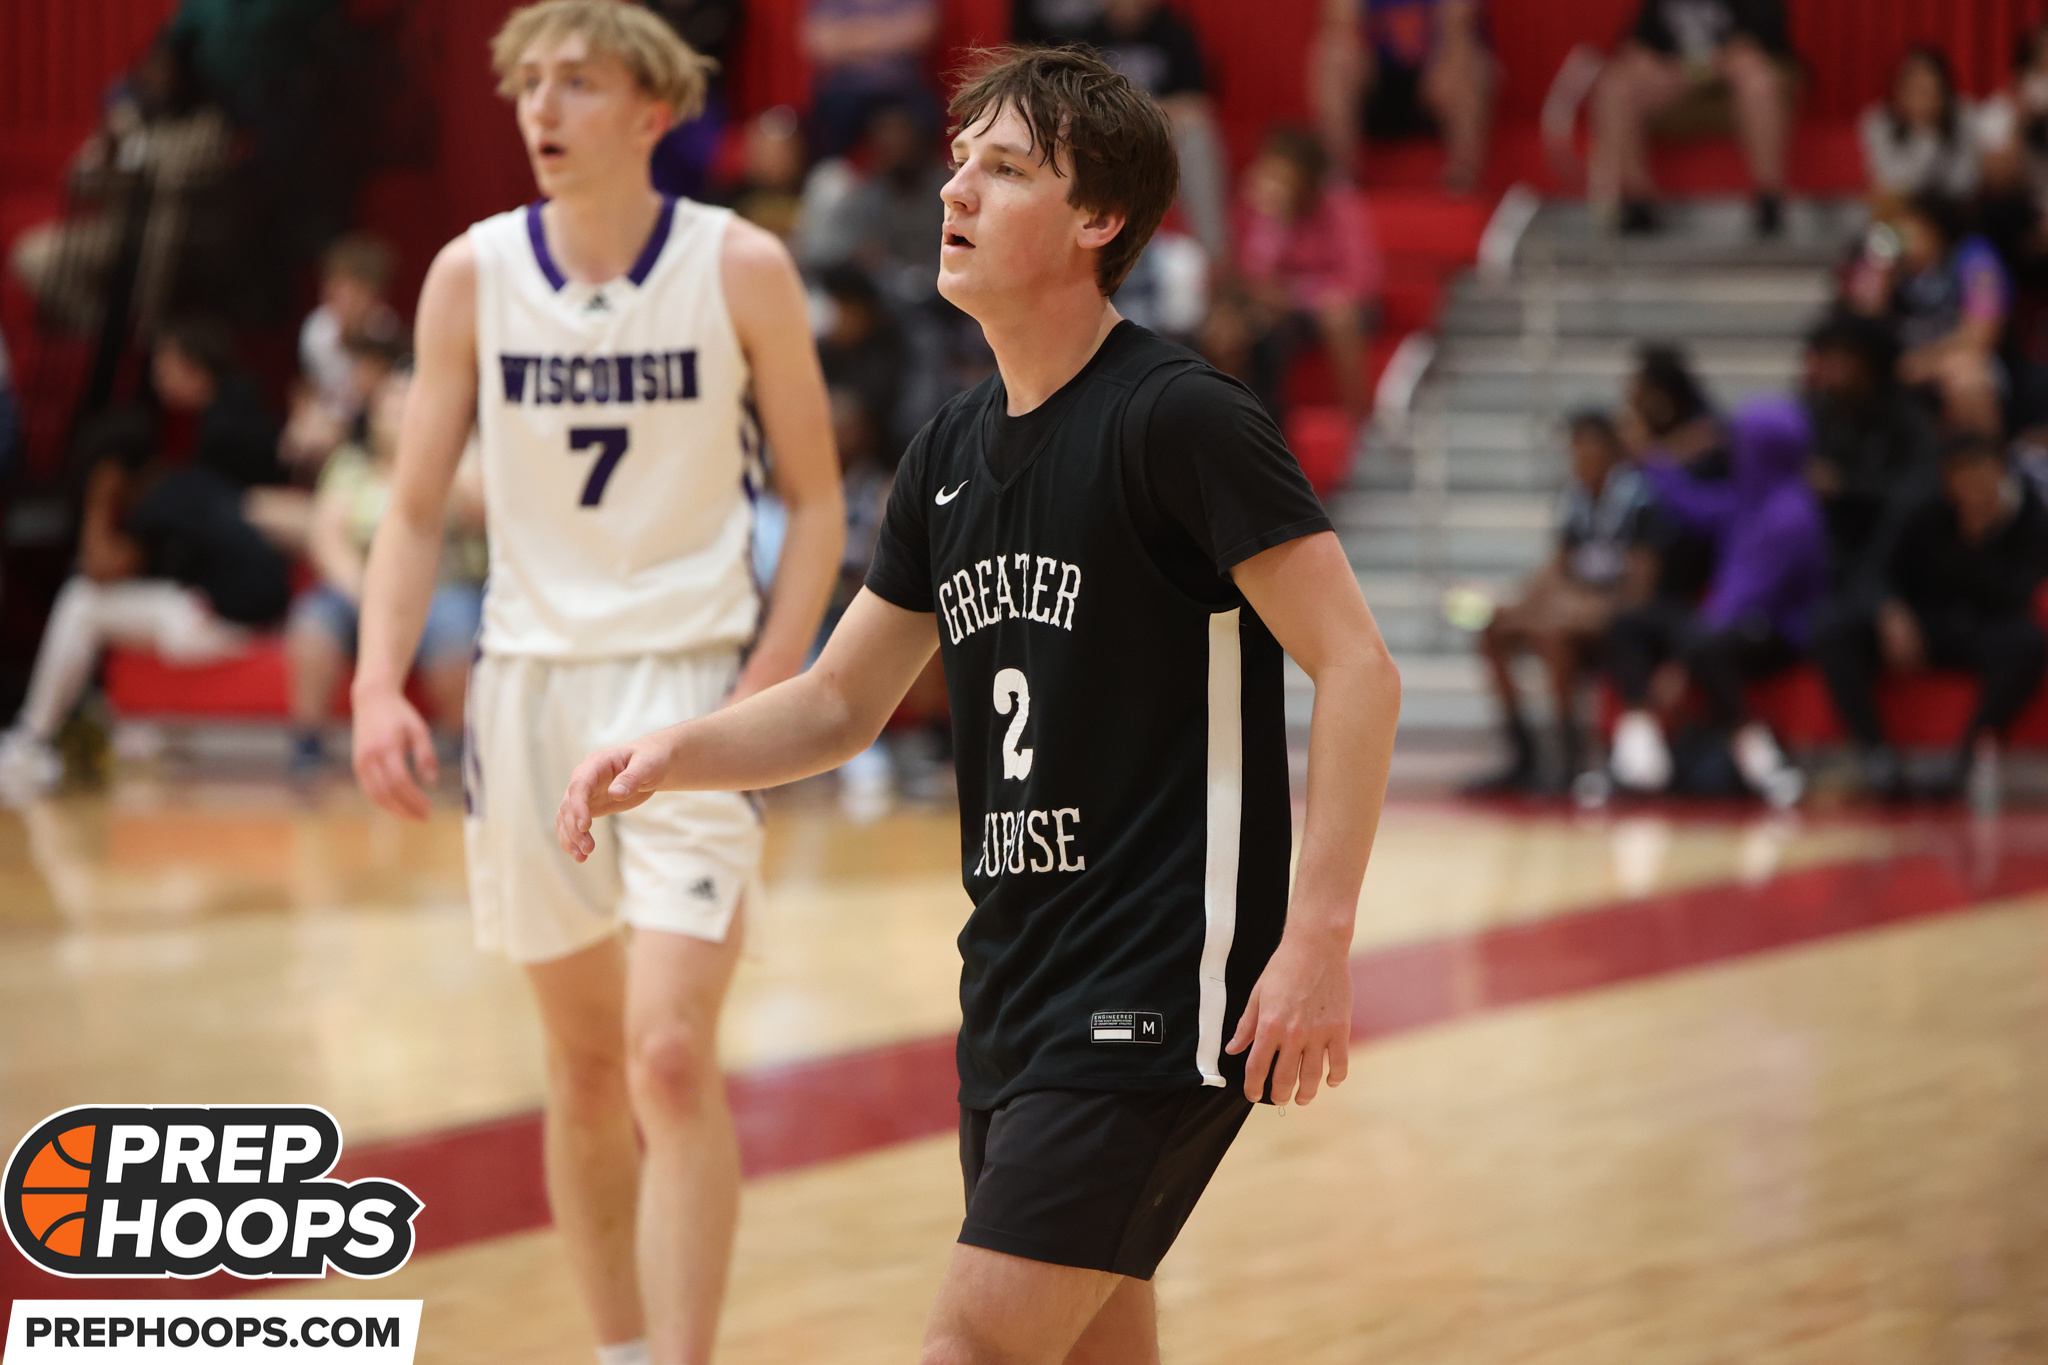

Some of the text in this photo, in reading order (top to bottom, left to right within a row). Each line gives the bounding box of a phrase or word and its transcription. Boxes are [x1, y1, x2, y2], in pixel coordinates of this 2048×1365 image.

[569, 427, 629, 507] 7
[938, 553, 1081, 646] GREATER
[993, 667, 1033, 781] 2
[1142, 1021, 1155, 1034] M
